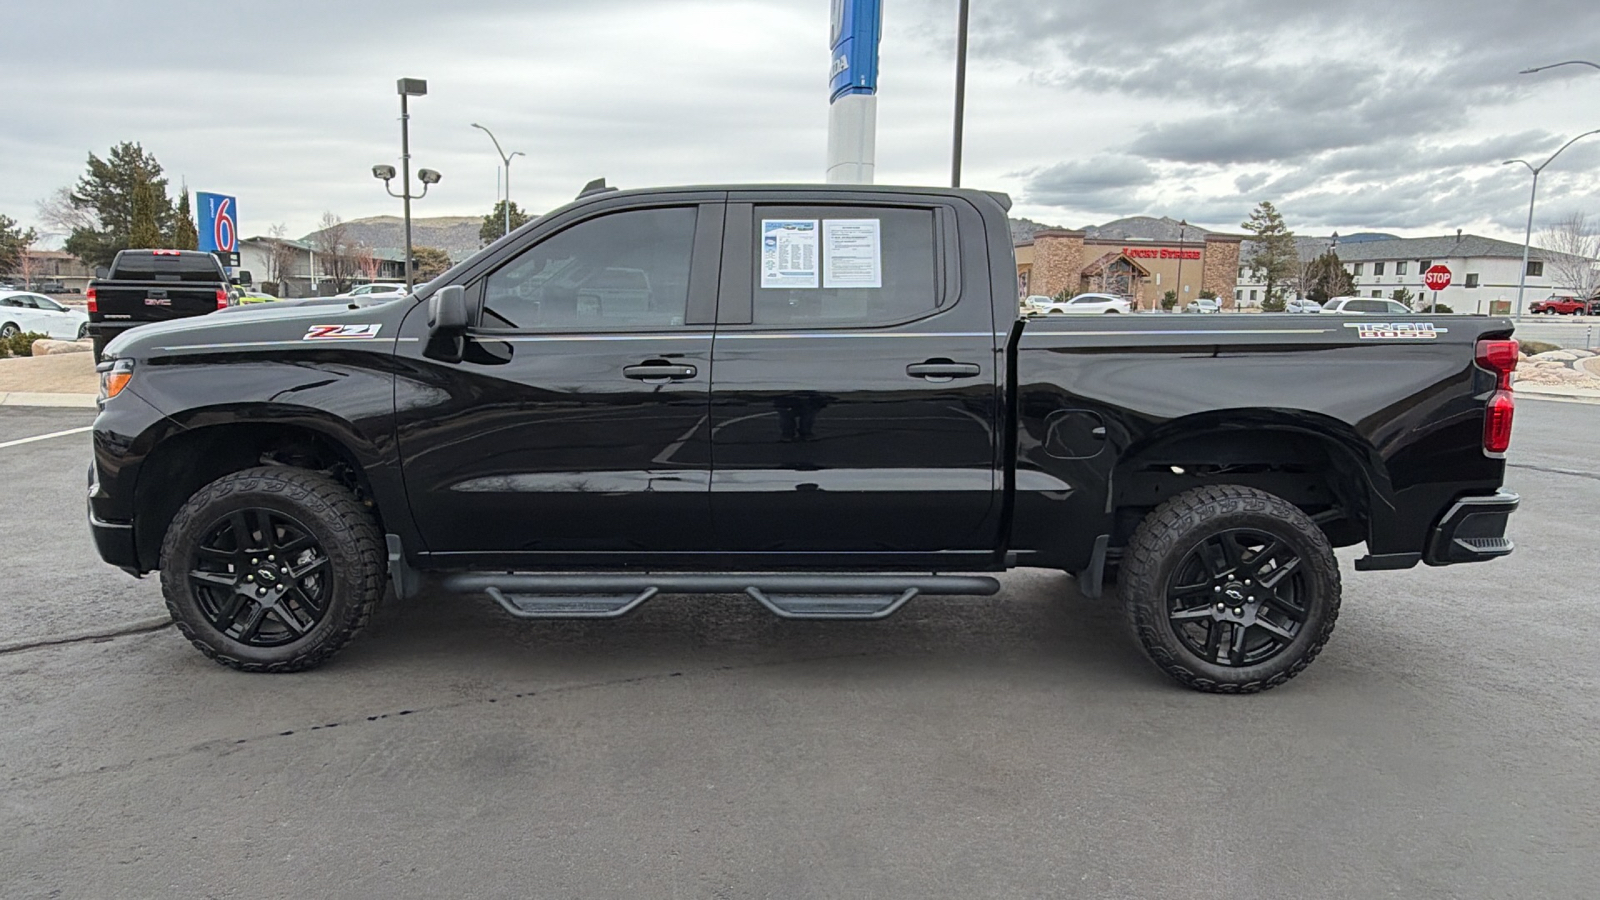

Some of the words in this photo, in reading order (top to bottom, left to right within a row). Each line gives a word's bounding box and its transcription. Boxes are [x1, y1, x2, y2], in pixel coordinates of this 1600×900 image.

[214, 198, 235, 252] 6
[1122, 245, 1159, 259] LUCKY
[1160, 247, 1201, 260] STRIKE
[1426, 272, 1451, 284] STOP
[144, 298, 172, 306] GMC
[1343, 322, 1448, 333] TRAIL
